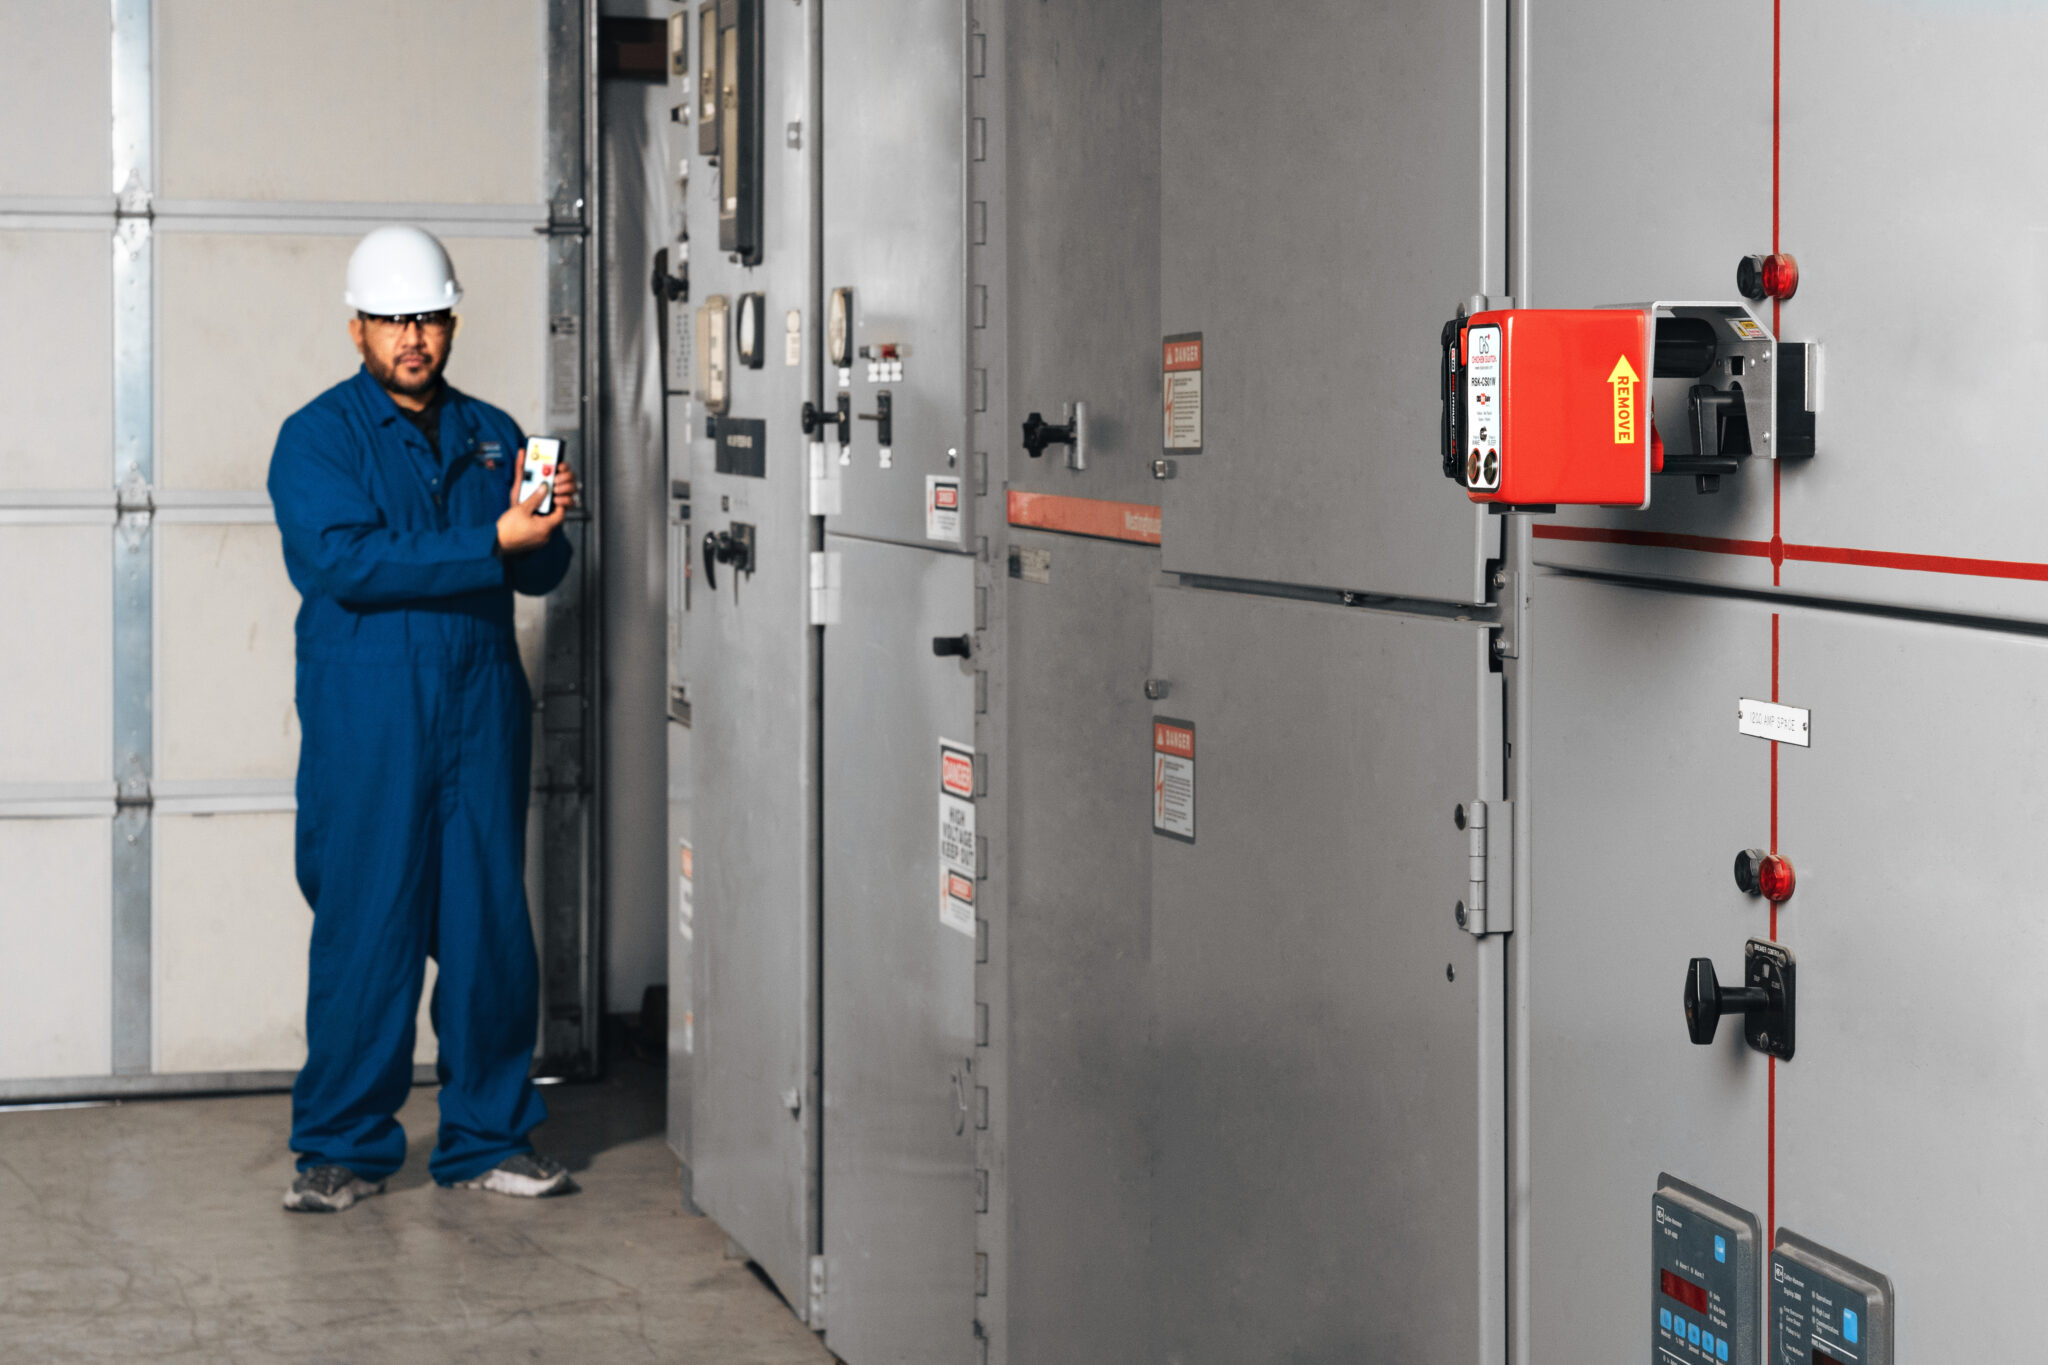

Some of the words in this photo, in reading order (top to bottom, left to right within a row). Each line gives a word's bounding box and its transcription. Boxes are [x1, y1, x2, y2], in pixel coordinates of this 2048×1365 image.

[1175, 345, 1198, 363] DANGER
[1617, 376, 1630, 441] REMOVE
[1165, 729, 1191, 751] DANGER
[949, 806, 966, 826] HIGH
[942, 822, 973, 848] VOLTAGE
[942, 841, 959, 859] KEEP
[960, 848, 974, 866] OUT
